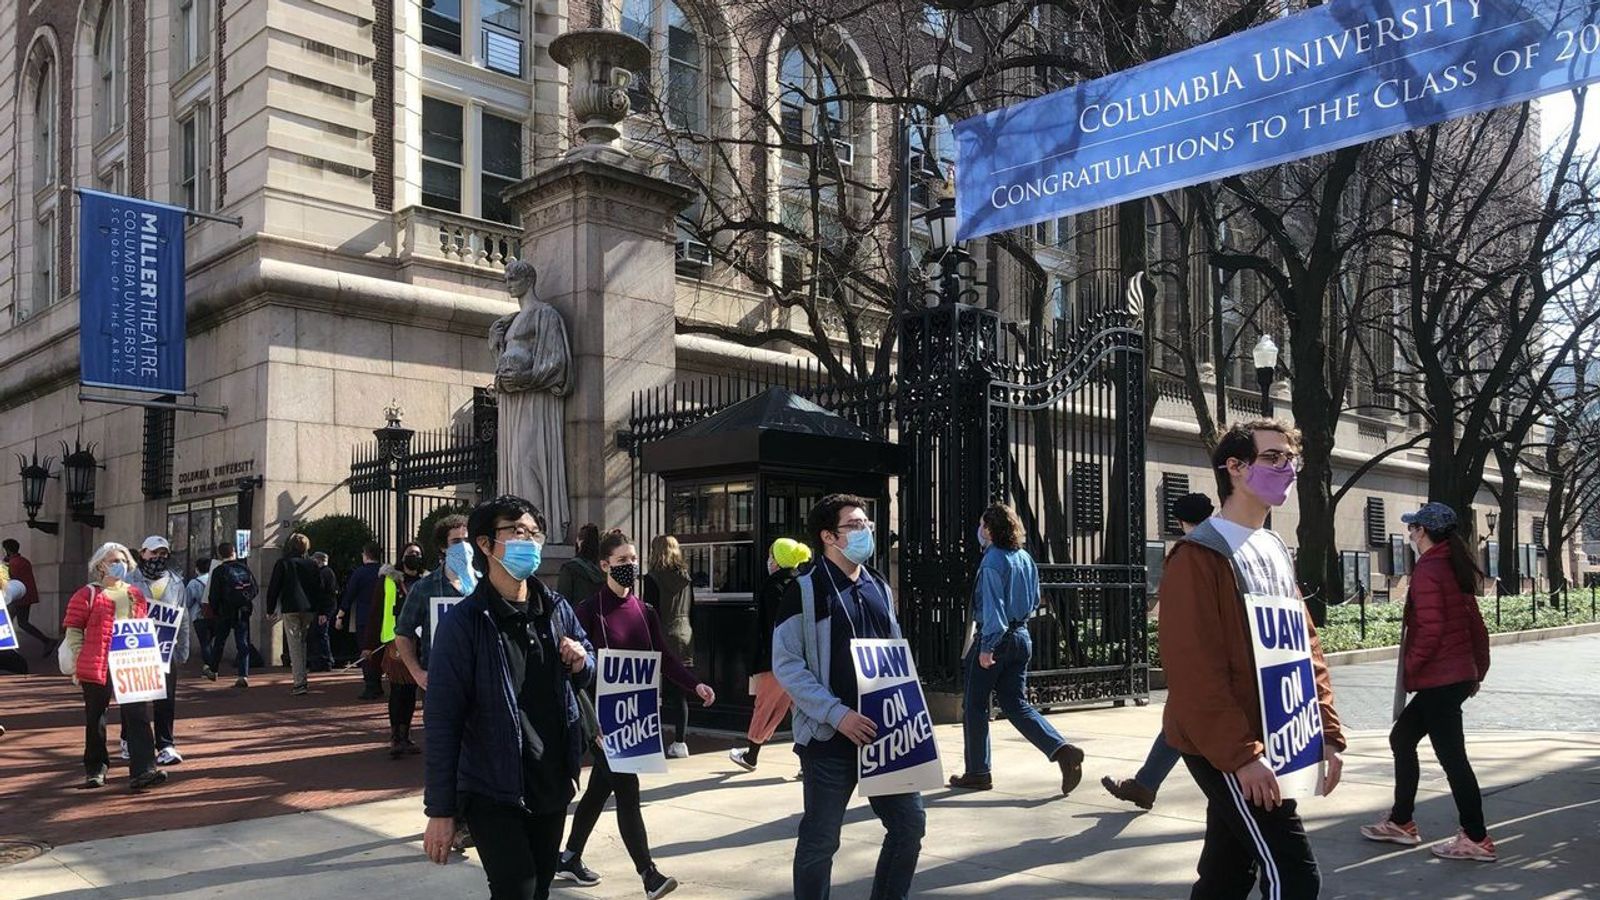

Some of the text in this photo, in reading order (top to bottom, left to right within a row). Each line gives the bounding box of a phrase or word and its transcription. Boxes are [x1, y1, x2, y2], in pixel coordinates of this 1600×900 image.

[1078, 0, 1482, 135] COLUMBIA UNIVERSITY
[991, 130, 1235, 211] CONGRATULATIONS
[1247, 114, 1288, 144] TO
[1298, 90, 1361, 131] THE
[1373, 60, 1478, 110] CLASS
[1493, 43, 1540, 76] OF
[111, 208, 120, 265] SCHOOL
[123, 210, 137, 376] COLUMBIA UNIVERSITY
[111, 338, 120, 374] ARTS
[146, 602, 179, 624] AW
[1255, 606, 1306, 652] UAW
[117, 665, 163, 694] STRIKE
[603, 656, 656, 684] UAW
[856, 646, 910, 679] UAW
[615, 693, 638, 724] ON
[883, 689, 909, 728] ON
[1281, 666, 1304, 714] ON
[603, 712, 659, 757] STRIKE
[861, 710, 932, 774] STRIKE
[1268, 697, 1321, 771] STRIKE
